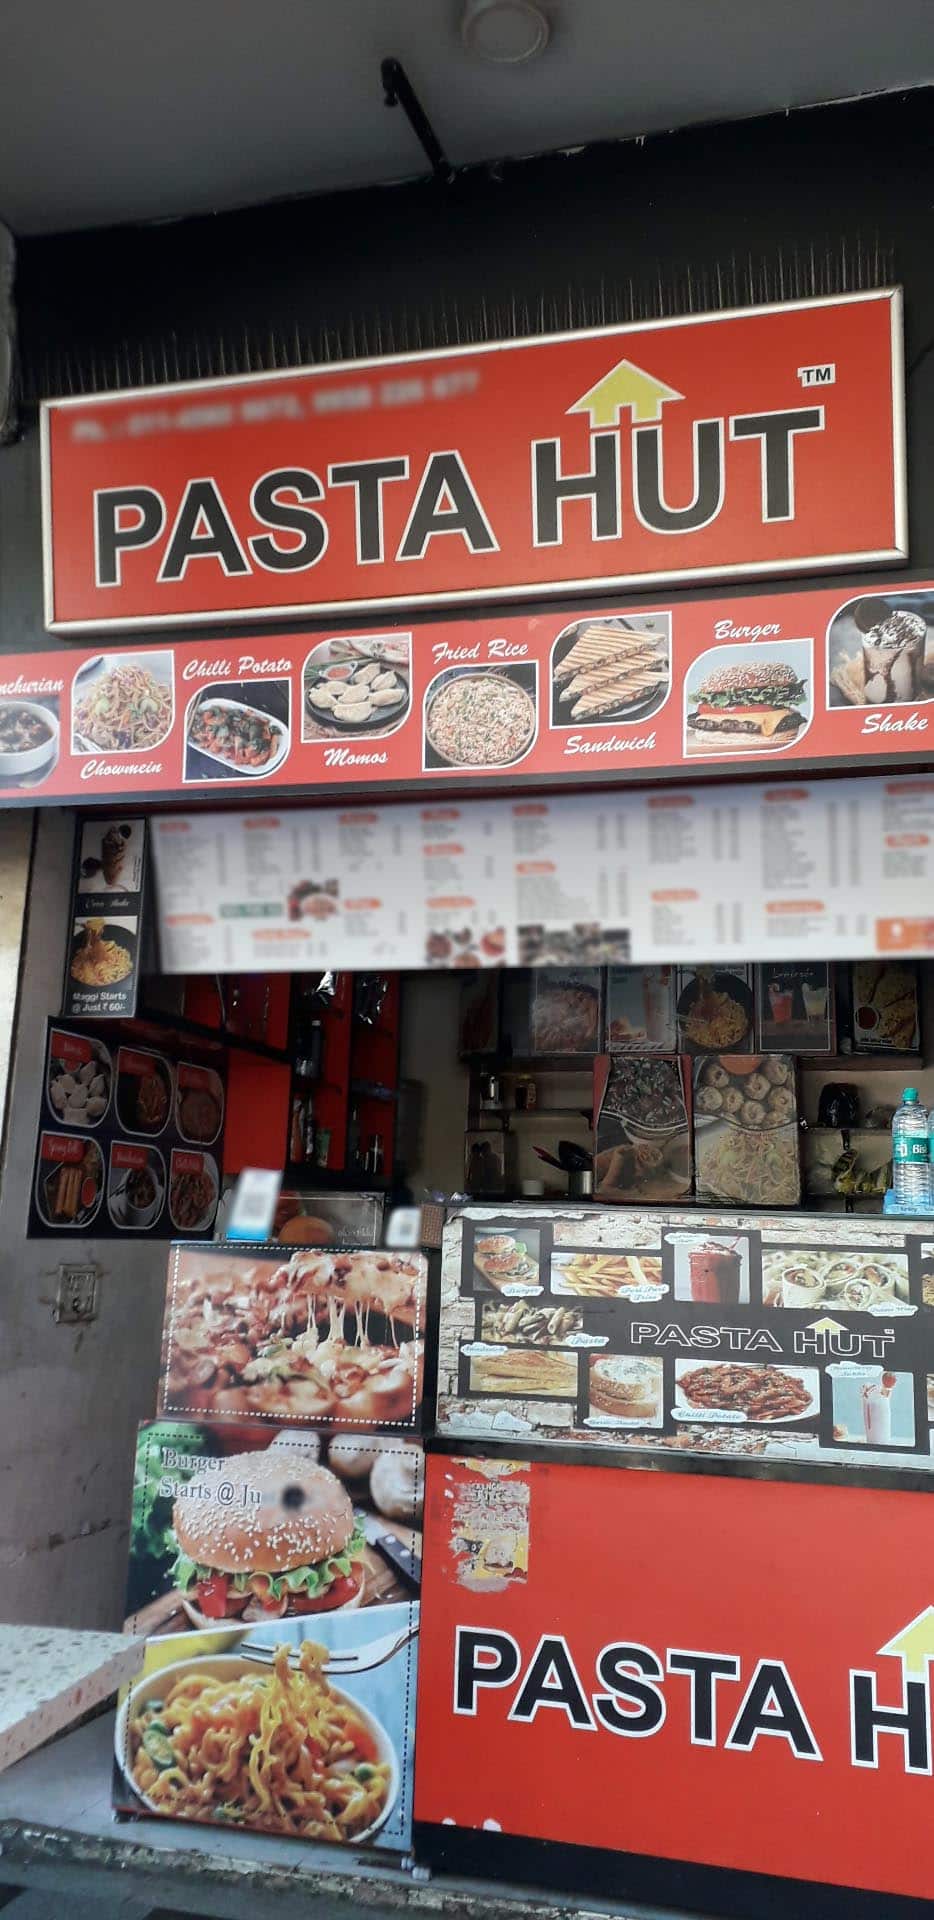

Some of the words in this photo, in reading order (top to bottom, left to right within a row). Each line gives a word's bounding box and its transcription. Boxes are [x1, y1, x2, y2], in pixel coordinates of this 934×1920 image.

[801, 366, 834, 385] TM
[93, 449, 500, 589] PASTA
[530, 405, 826, 549] HUT
[713, 619, 782, 641] Burger
[432, 641, 480, 664] Fried
[487, 640, 528, 659] Rice
[182, 660, 231, 679] Chilli
[238, 654, 292, 675] Potato
[861, 712, 929, 736] Shake
[564, 730, 656, 756] Sandwich
[323, 746, 388, 768] Momos
[79, 759, 162, 782] Chowmein
[630, 1322, 784, 1354] PASTA
[793, 1327, 896, 1359] HUT
[162, 1448, 226, 1471] Burger
[159, 1476, 212, 1499] Starts
[217, 1481, 236, 1503] @
[453, 1625, 825, 1761] PASTA
